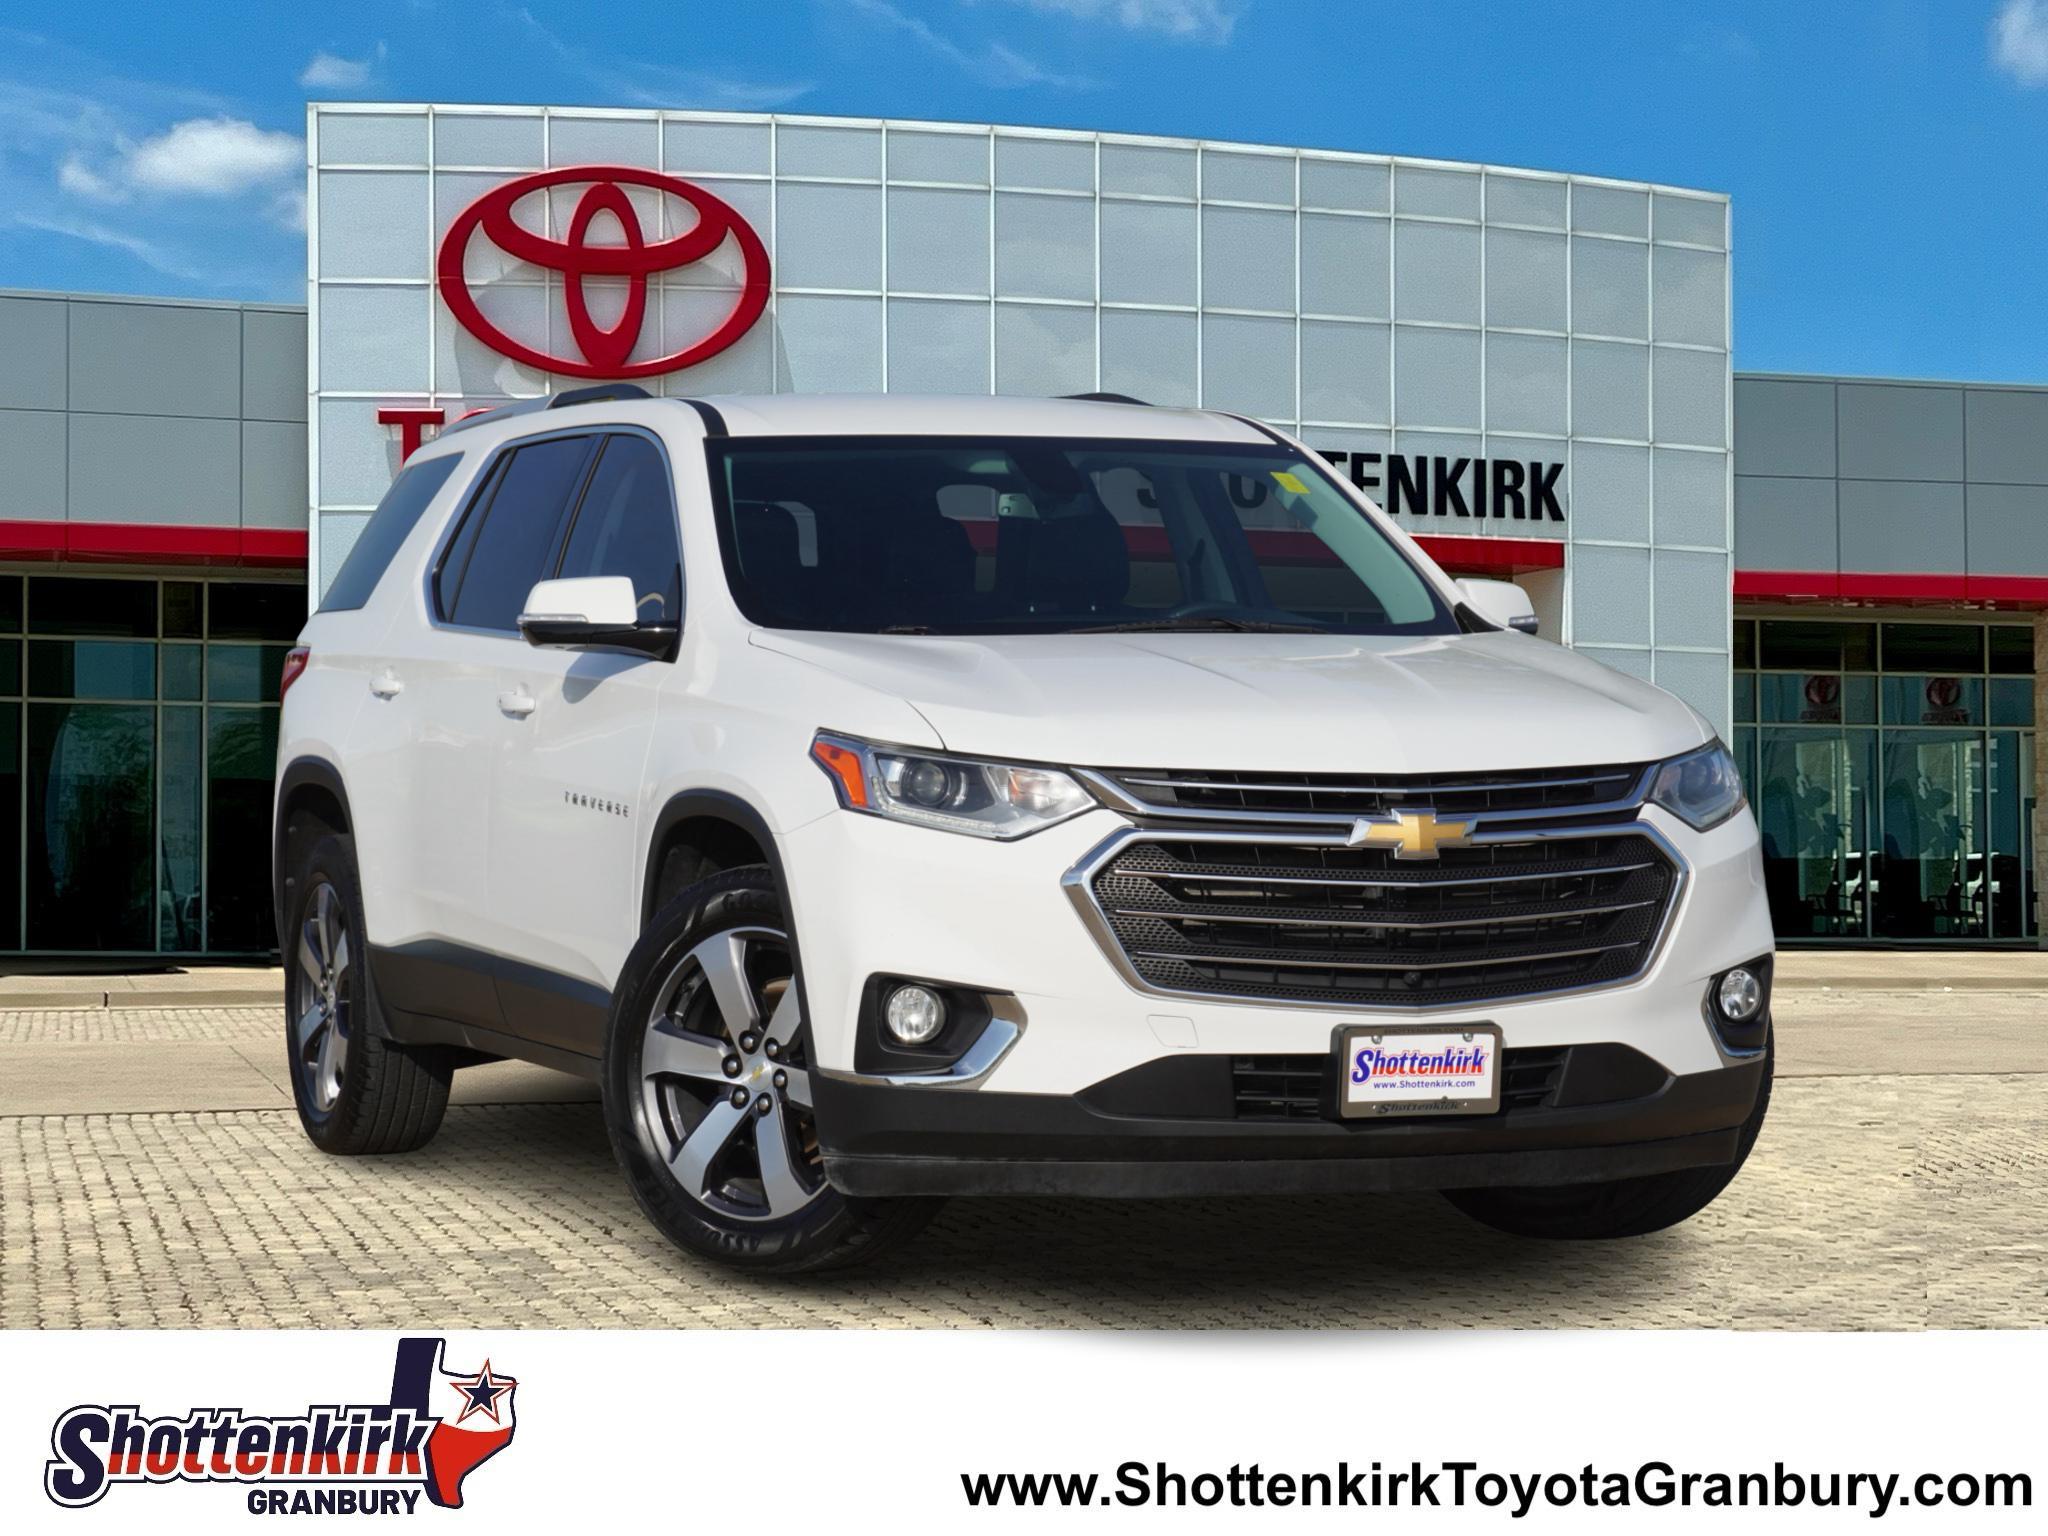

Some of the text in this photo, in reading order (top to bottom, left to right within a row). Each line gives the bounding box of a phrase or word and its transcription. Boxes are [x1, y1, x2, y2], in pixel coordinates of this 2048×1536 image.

[564, 791, 629, 818] TRAVERSE
[1352, 1047, 1486, 1083] Shottenkirk
[1373, 1079, 1476, 1089] www.Shottenkirk.com
